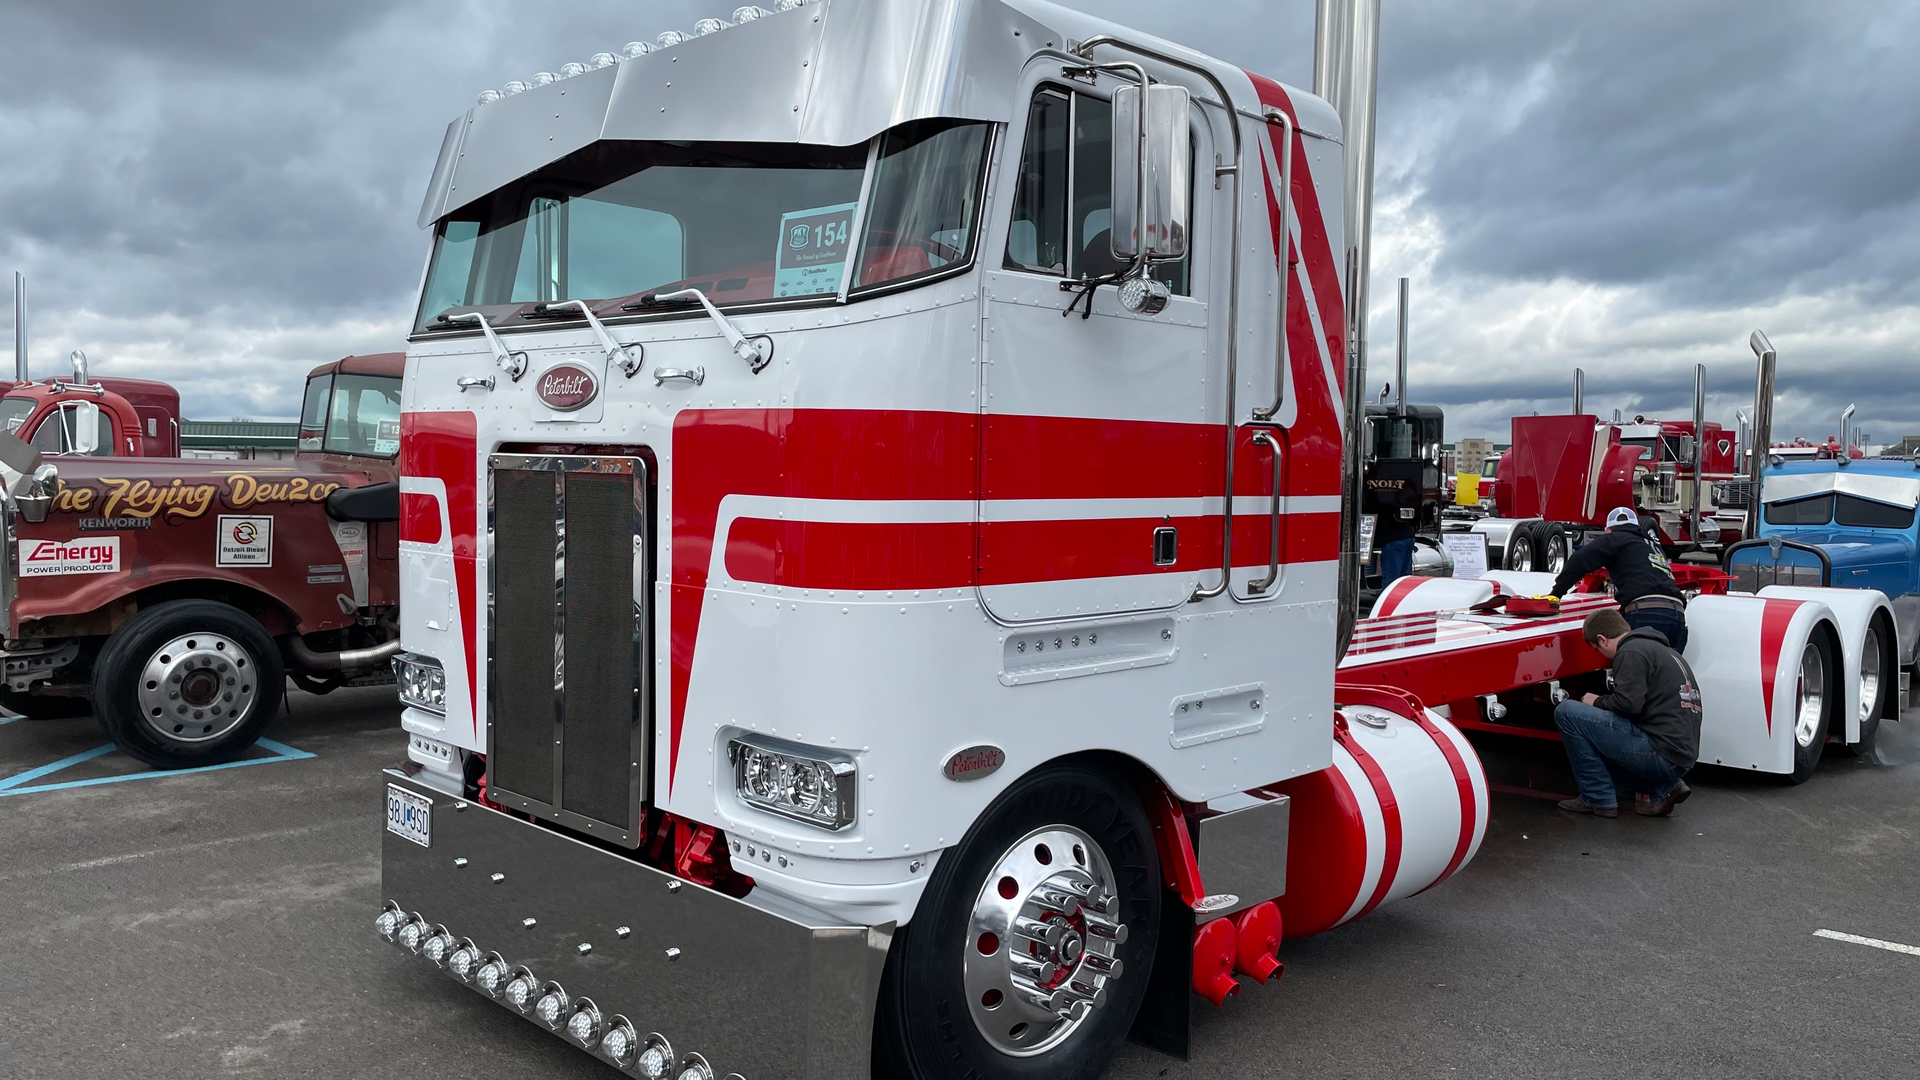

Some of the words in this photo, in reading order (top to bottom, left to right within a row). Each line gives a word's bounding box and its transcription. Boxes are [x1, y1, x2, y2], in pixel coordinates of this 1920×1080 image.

[814, 220, 847, 248] 154
[543, 374, 588, 397] Peterbilt
[1367, 480, 1406, 490] NOLT
[51, 478, 93, 511] he
[99, 477, 216, 518] Flying
[79, 518, 151, 529] KENWORTH
[27, 542, 113, 564] Energy
[63, 564, 113, 572] PRODUCTS
[951, 750, 1002, 776] Peterbilt
